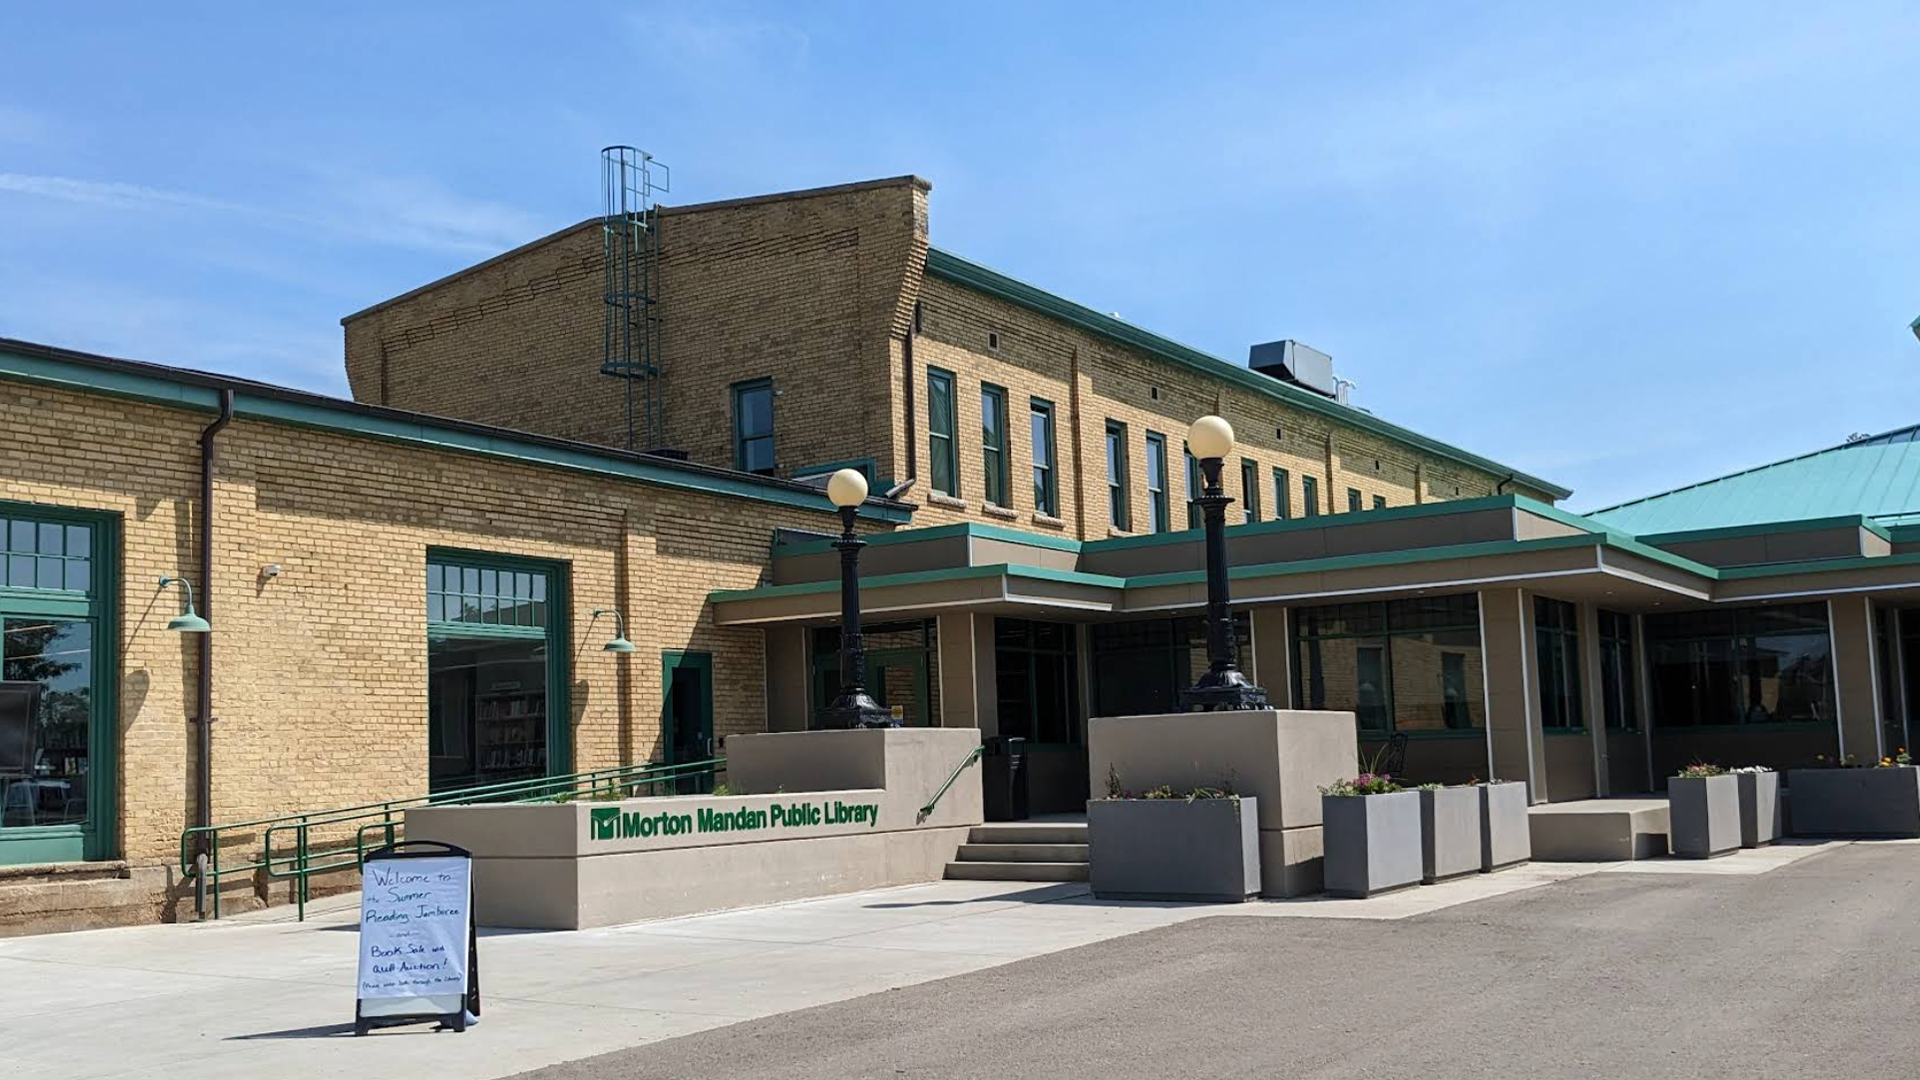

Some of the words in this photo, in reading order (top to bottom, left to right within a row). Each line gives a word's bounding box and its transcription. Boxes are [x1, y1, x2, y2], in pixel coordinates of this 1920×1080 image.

[623, 811, 692, 839] Morton
[697, 806, 767, 833] Mandan
[770, 803, 821, 827] Public
[824, 801, 878, 827] Library
[372, 866, 430, 886] Welcome
[437, 872, 451, 882] to
[366, 894, 380, 903] the
[386, 886, 432, 903] Summer
[366, 909, 410, 924] Reading
[415, 904, 460, 919] Jamboree
[371, 945, 402, 958] Book
[406, 943, 427, 954] Sale
